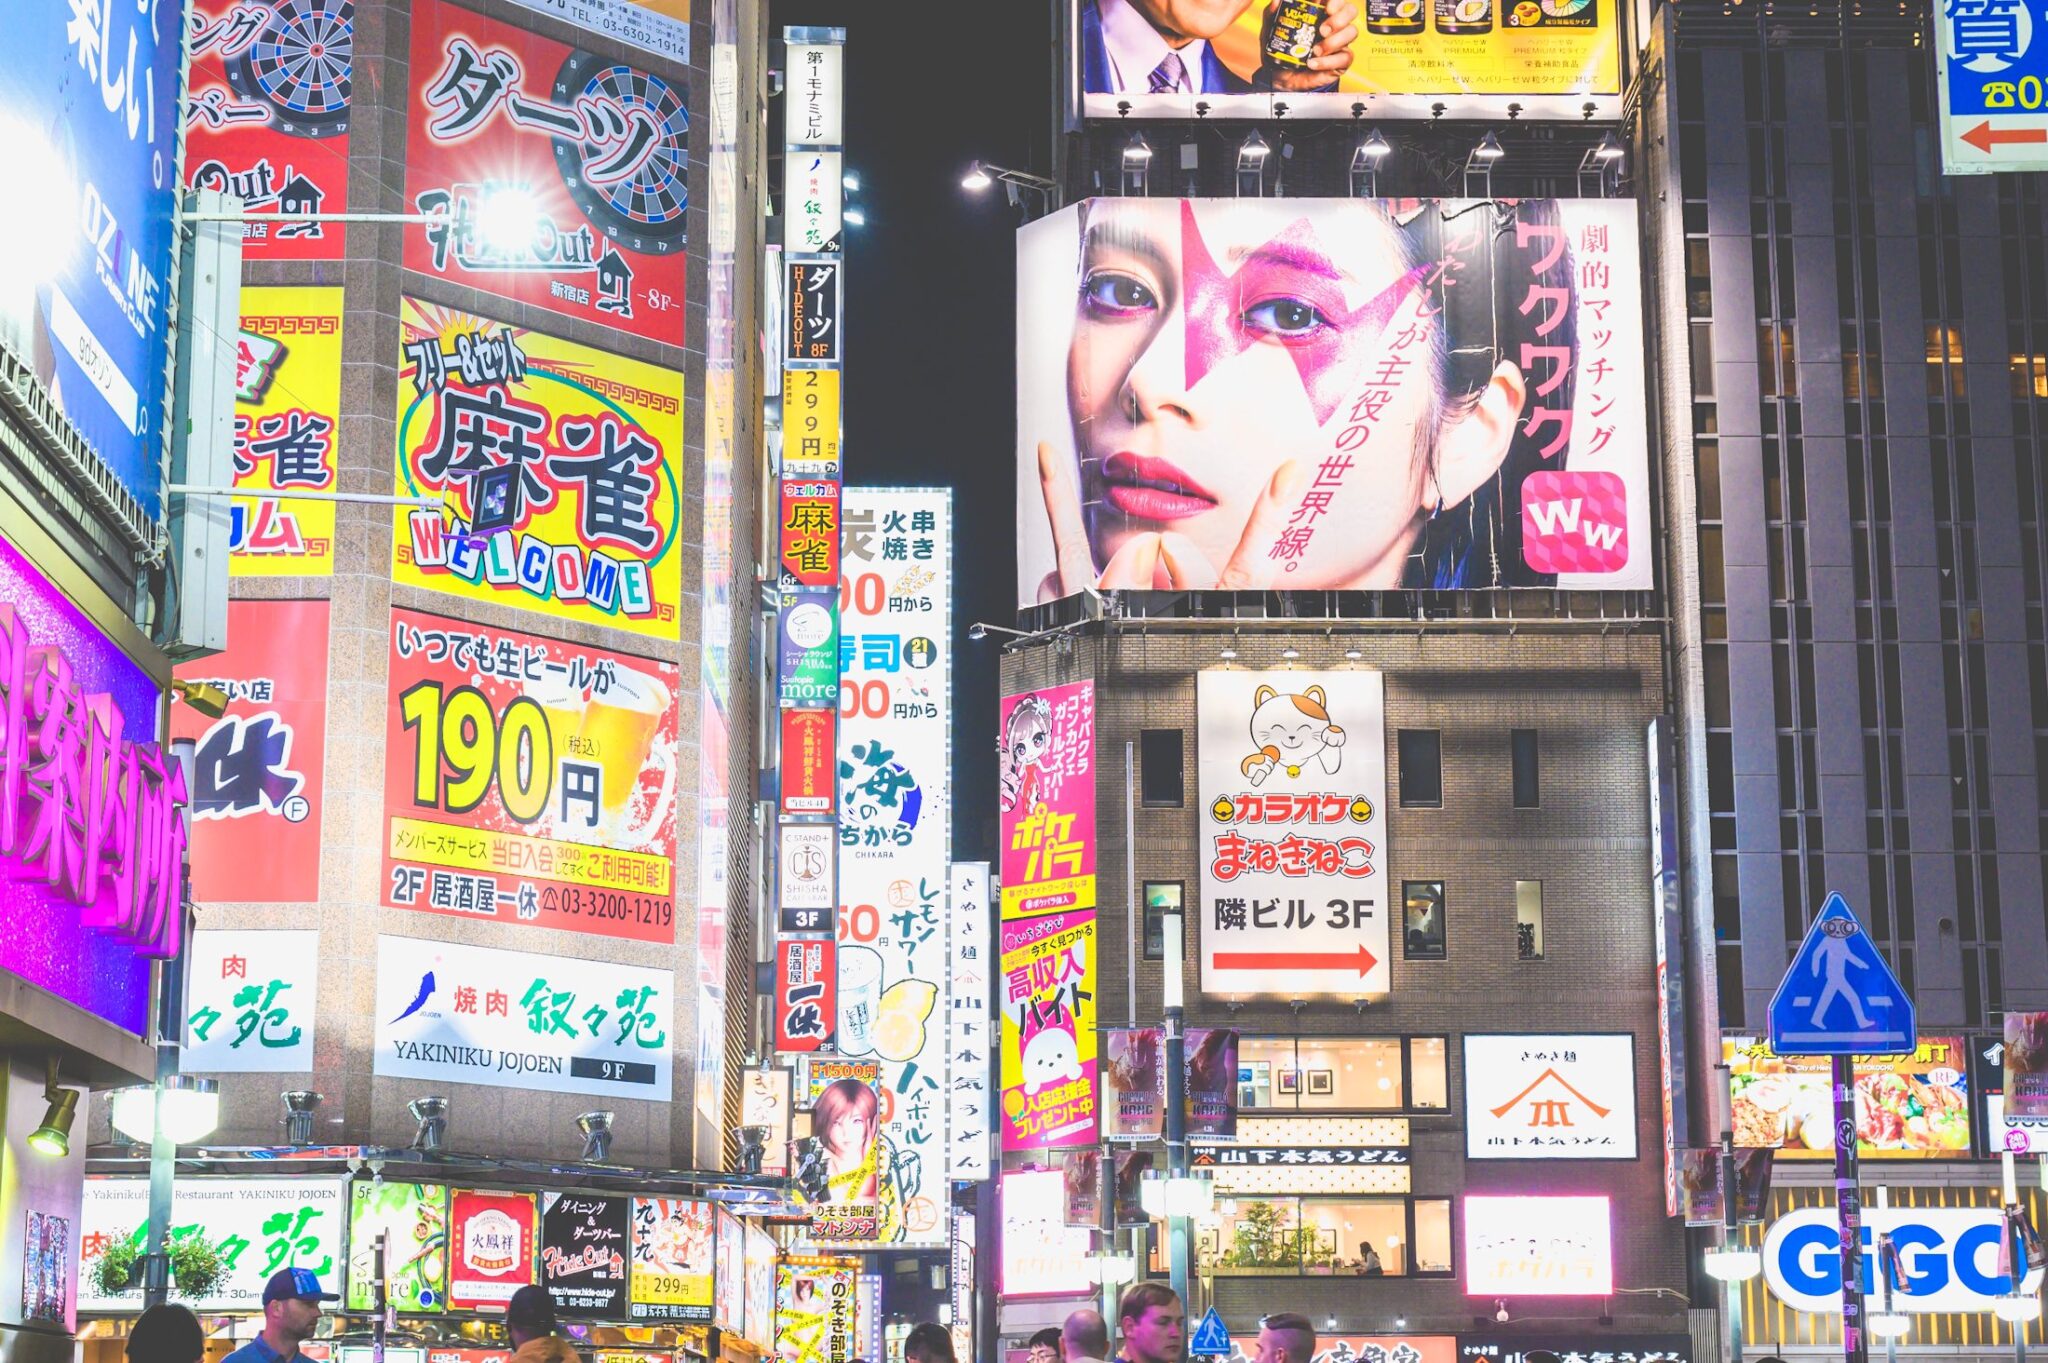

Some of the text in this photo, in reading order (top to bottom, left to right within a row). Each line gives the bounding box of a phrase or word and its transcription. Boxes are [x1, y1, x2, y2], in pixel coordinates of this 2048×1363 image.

[430, 42, 657, 180] ダーツ
[806, 51, 823, 139] 第1モナミビル
[827, 240, 840, 251] 9F
[550, 281, 589, 305] 新宿店
[794, 266, 804, 357] HIDEOUT
[807, 266, 834, 339] ダーツ
[811, 343, 829, 357] 8F
[1516, 222, 1570, 460] ワクワク
[1580, 223, 1615, 457] 劇的マッチング
[420, 388, 657, 549] 麻雀
[784, 485, 837, 498] ウェルカム
[786, 502, 834, 572] 麻雀
[411, 515, 647, 606] WELCOME
[782, 574, 797, 585] 6F
[783, 596, 797, 607] 5F
[889, 596, 933, 613] 円から
[399, 624, 616, 694] いつでも生ビールが
[781, 684, 837, 698] more
[894, 703, 938, 719] 円から
[400, 679, 553, 824] 190
[1051, 701, 1066, 801] ガールズバー
[1065, 695, 1079, 776] コンカフェ
[1078, 686, 1092, 776] キャバクラ
[561, 762, 600, 827] 円
[860, 804, 878, 820] の
[1235, 795, 1350, 822] カラオケ
[395, 830, 553, 873] メンバーズサービス 当日入会
[855, 851, 894, 859] CHIKARA
[1211, 830, 1375, 882] まねきねこ
[392, 868, 671, 926] 2F 居酒屋一休 03-3200-1219
[1214, 898, 1374, 931] 隣ビル 3F
[795, 911, 819, 927] 3F
[1017, 915, 1064, 943] いちごなび
[1031, 925, 1093, 957] 今すぐ見つかる
[222, 955, 246, 979] 肉
[790, 945, 802, 983] 居酒屋
[1006, 947, 1085, 1004] 高収入
[454, 978, 666, 1049] 焼肉 叙々苑
[787, 984, 822, 1036] 一休
[1018, 982, 1092, 1037] バイト
[394, 1040, 626, 1080] YAKINIKU JOJOEN 9F
[820, 1043, 833, 1051] 2F
[896, 1062, 939, 1144] ハイボール
[1221, 1149, 1407, 1163] 山下本気うどん
[175, 1190, 233, 1200] Restaurant
[239, 1190, 295, 1200] YAKINIKU
[298, 1189, 336, 1200] JOJOEN
[472, 1234, 513, 1250] 火鳳祥
[633, 1204, 656, 1262] 九十九
[654, 1277, 689, 1295] 299円
